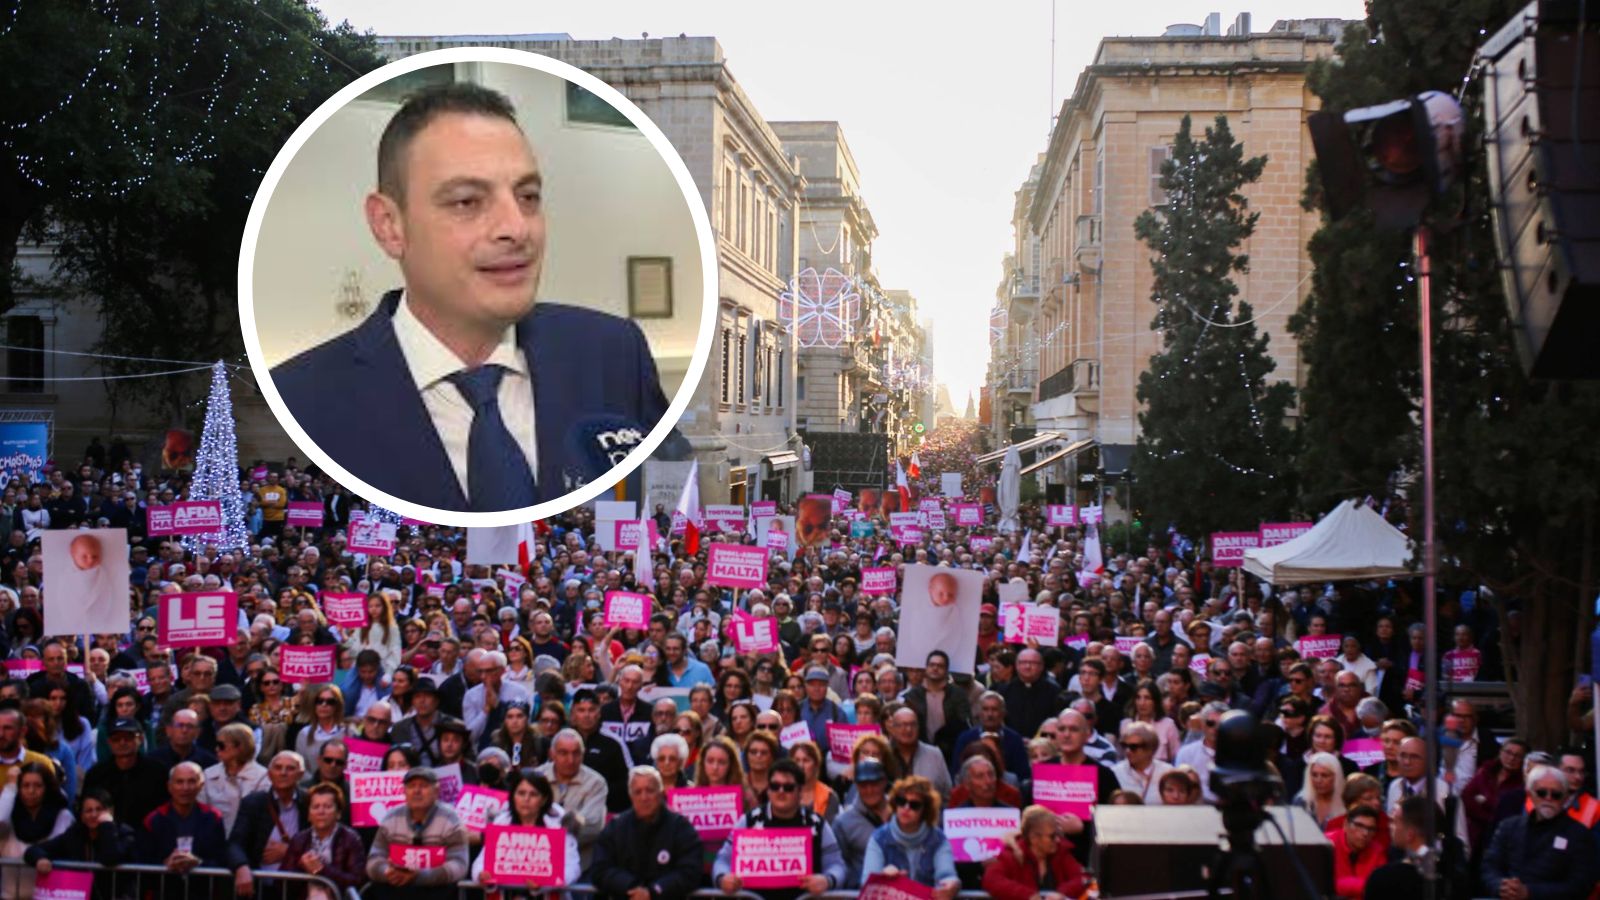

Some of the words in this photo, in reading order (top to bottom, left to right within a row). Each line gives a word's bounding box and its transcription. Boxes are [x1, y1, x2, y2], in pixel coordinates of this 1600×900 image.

[175, 506, 219, 519] AFDA
[1052, 506, 1073, 518] LE
[1262, 528, 1289, 539] DAN
[1214, 537, 1240, 547] DAN
[1241, 536, 1259, 546] HU
[1216, 548, 1244, 558] ABO
[714, 564, 761, 578] MALTA
[864, 580, 895, 588] ABORT
[168, 595, 225, 631] LE
[736, 620, 772, 643] LE
[1302, 640, 1326, 650] DAN
[1326, 638, 1341, 648] HU
[285, 664, 329, 674] MALTA
[688, 813, 734, 826] ALTA
[495, 847, 551, 863] FAVUR
[740, 858, 802, 872] MALTA
